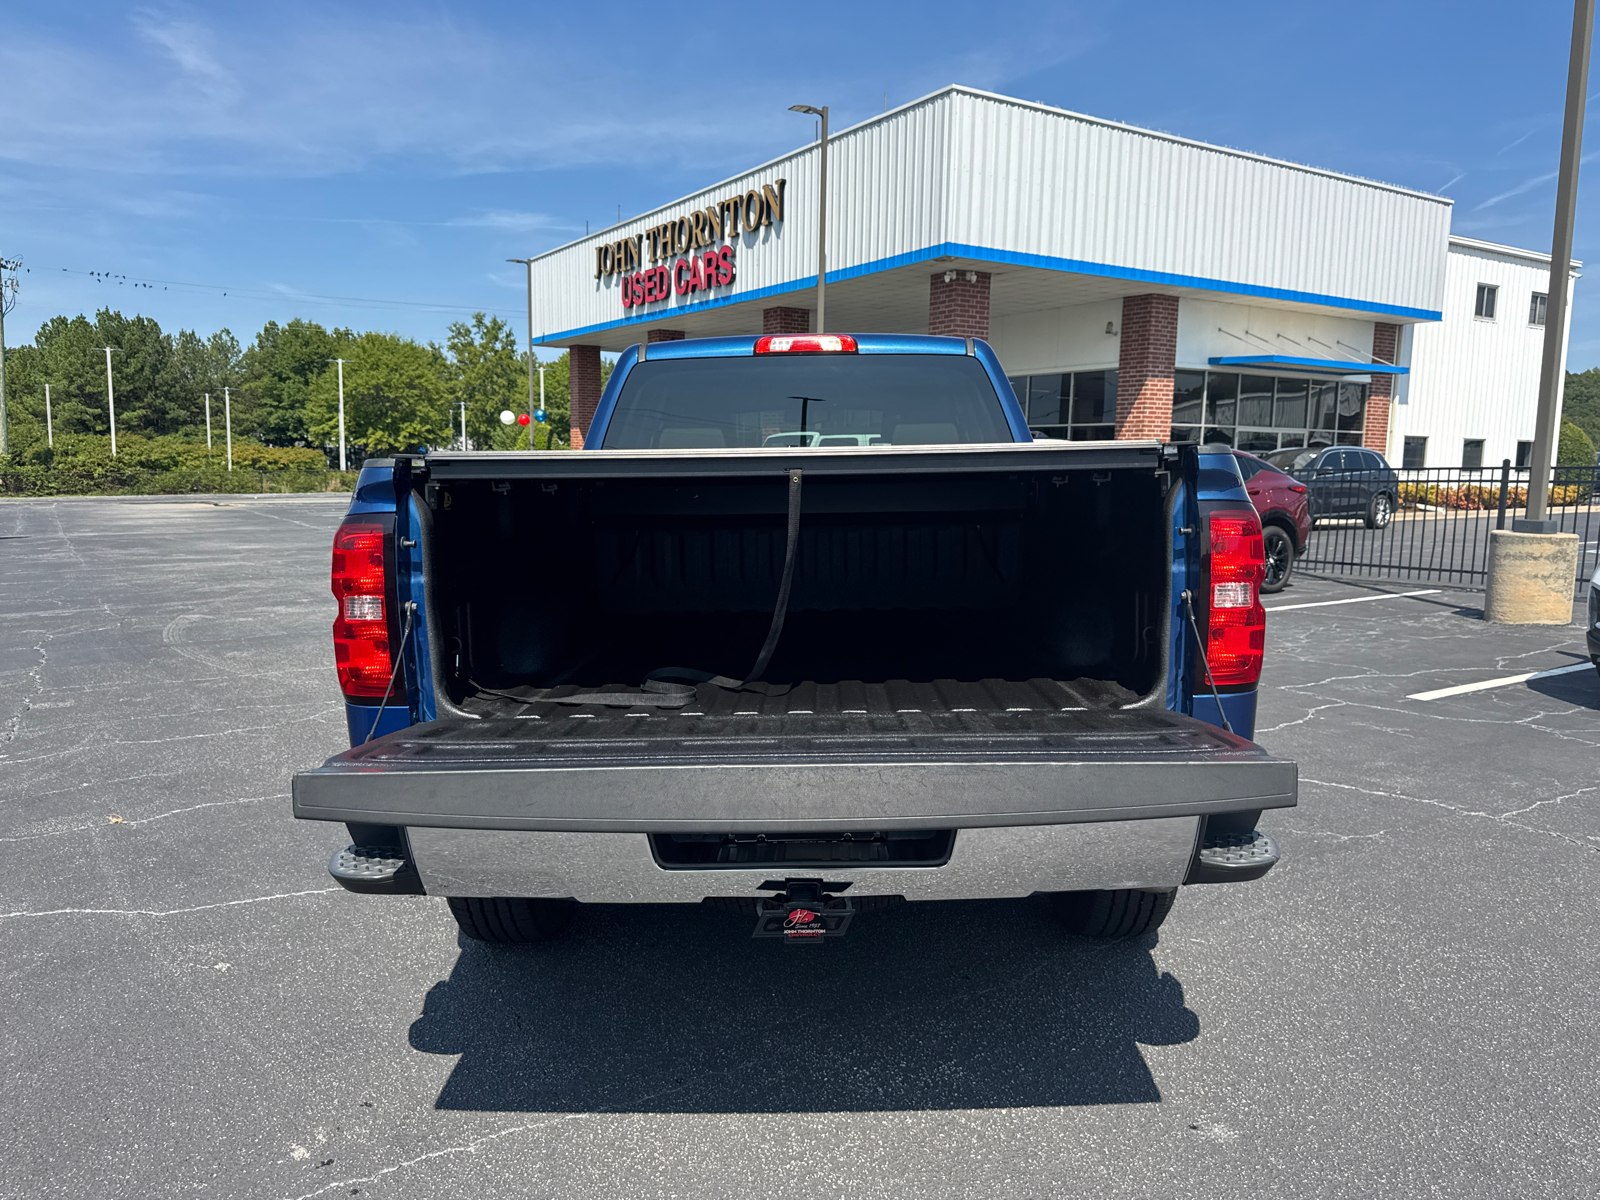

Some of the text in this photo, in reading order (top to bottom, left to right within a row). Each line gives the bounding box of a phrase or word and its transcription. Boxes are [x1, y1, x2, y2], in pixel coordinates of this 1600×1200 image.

[595, 179, 786, 279] JOHN THORNTON
[621, 245, 736, 308] USED CARS
